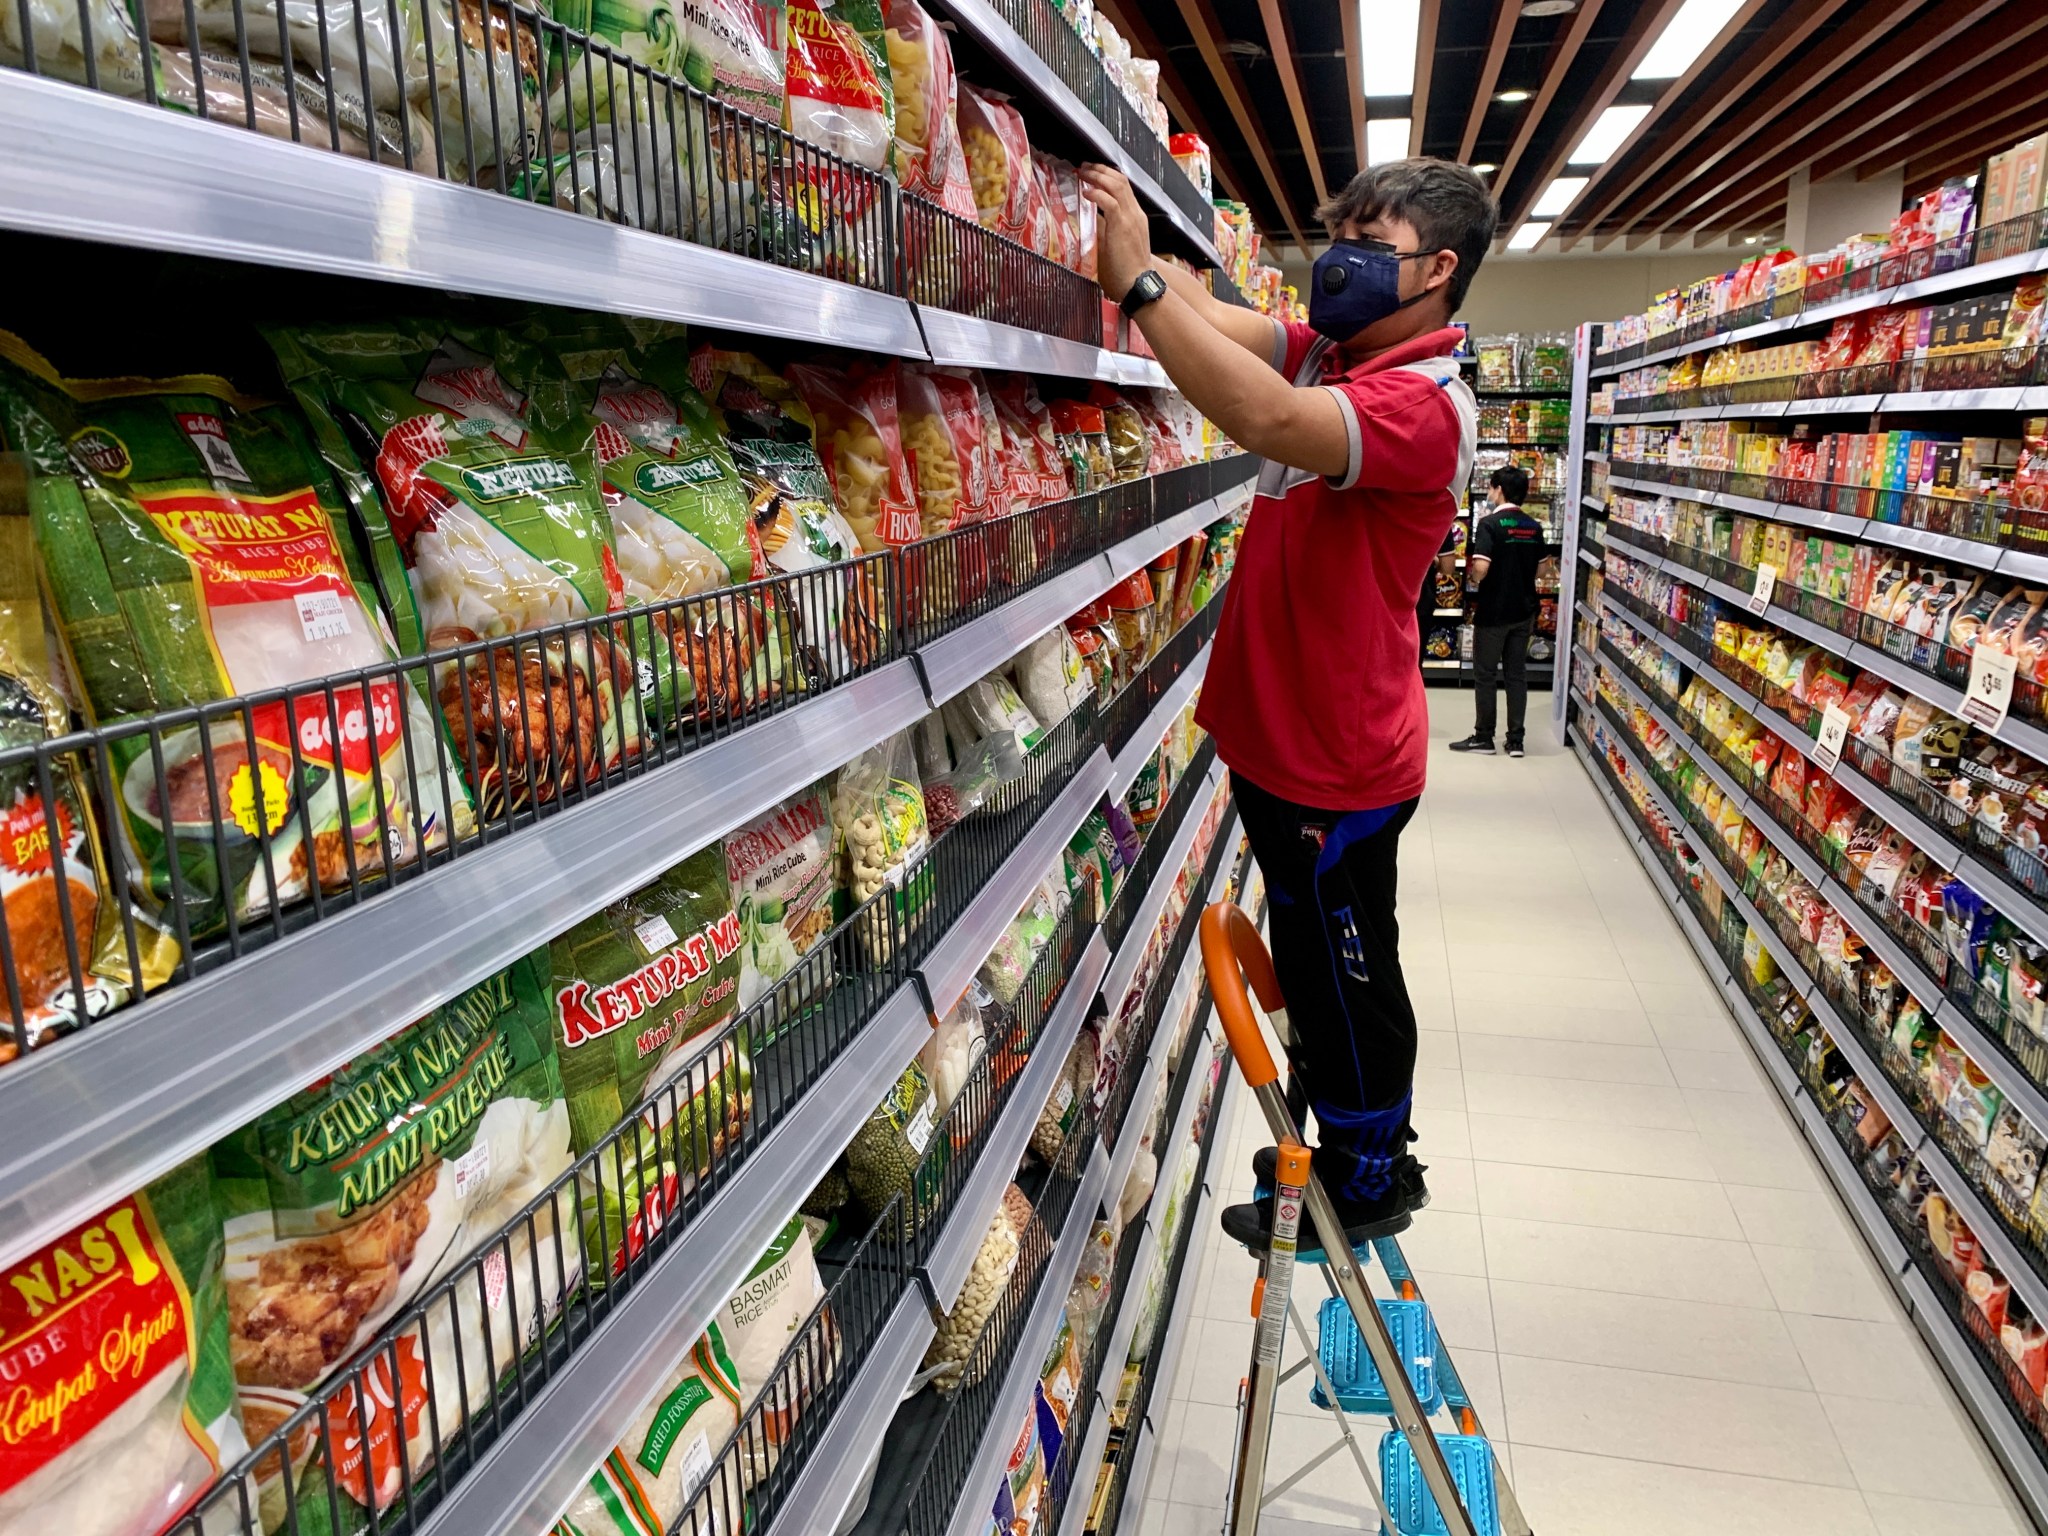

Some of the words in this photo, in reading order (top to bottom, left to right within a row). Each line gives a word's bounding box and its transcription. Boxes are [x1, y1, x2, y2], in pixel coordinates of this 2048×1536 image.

[683, 2, 708, 30] Mini
[813, 46, 839, 62] RICE
[473, 462, 577, 496] KETUPAT
[150, 509, 288, 554] KETUPAT
[238, 546, 279, 559] RICE
[282, 537, 326, 555] CUBE
[300, 695, 396, 751] adabi
[1126, 775, 1160, 804] Bihu
[755, 870, 772, 891] Mini
[772, 862, 788, 881] Rice
[787, 851, 807, 870] Cube
[556, 933, 711, 1047] KETUPAT
[635, 1018, 673, 1059] Mini
[701, 976, 736, 1009] Cube
[286, 1056, 418, 1171] KETUPAT
[337, 1121, 423, 1217] MINI
[10, 1207, 160, 1318] NASI
[729, 1259, 792, 1316] BASMATI
[734, 1303, 764, 1328] RICE
[99, 1301, 177, 1383] Sejati
[647, 1418, 672, 1465] DRIED
[667, 1384, 704, 1424] FOODSTUFF
[342, 1429, 390, 1475] Bunkus
